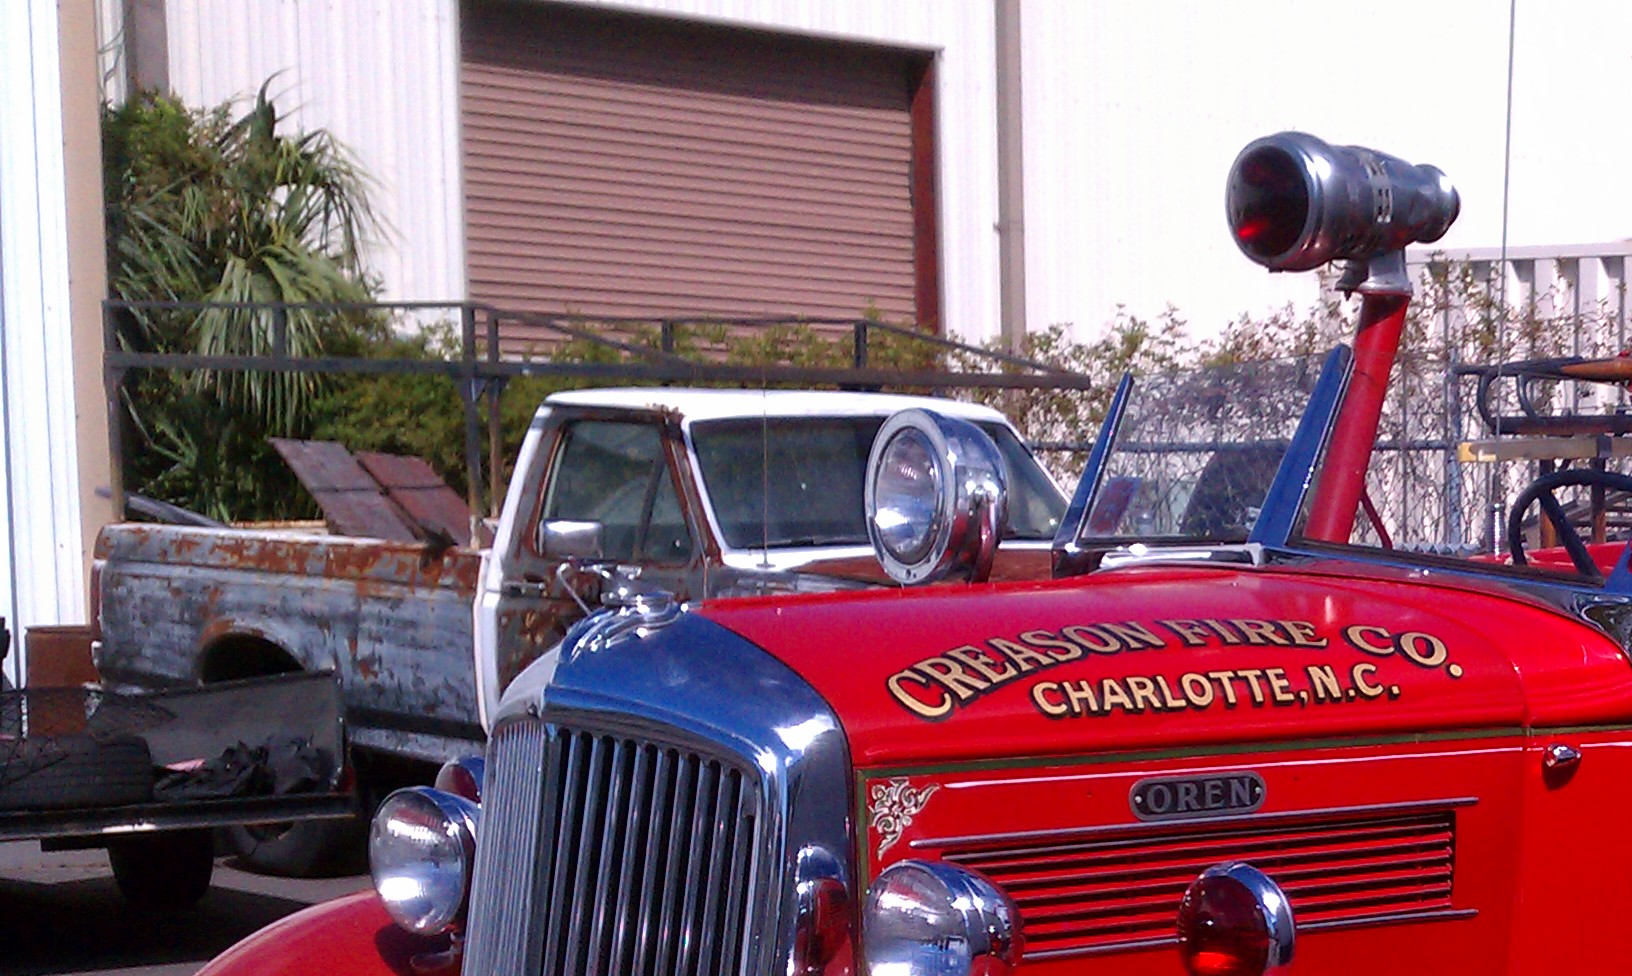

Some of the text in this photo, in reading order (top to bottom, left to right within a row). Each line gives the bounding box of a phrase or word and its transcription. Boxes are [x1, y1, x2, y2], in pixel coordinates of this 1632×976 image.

[886, 619, 1463, 719] CREASON FIRE CO.
[1146, 777, 1251, 814] OREN
